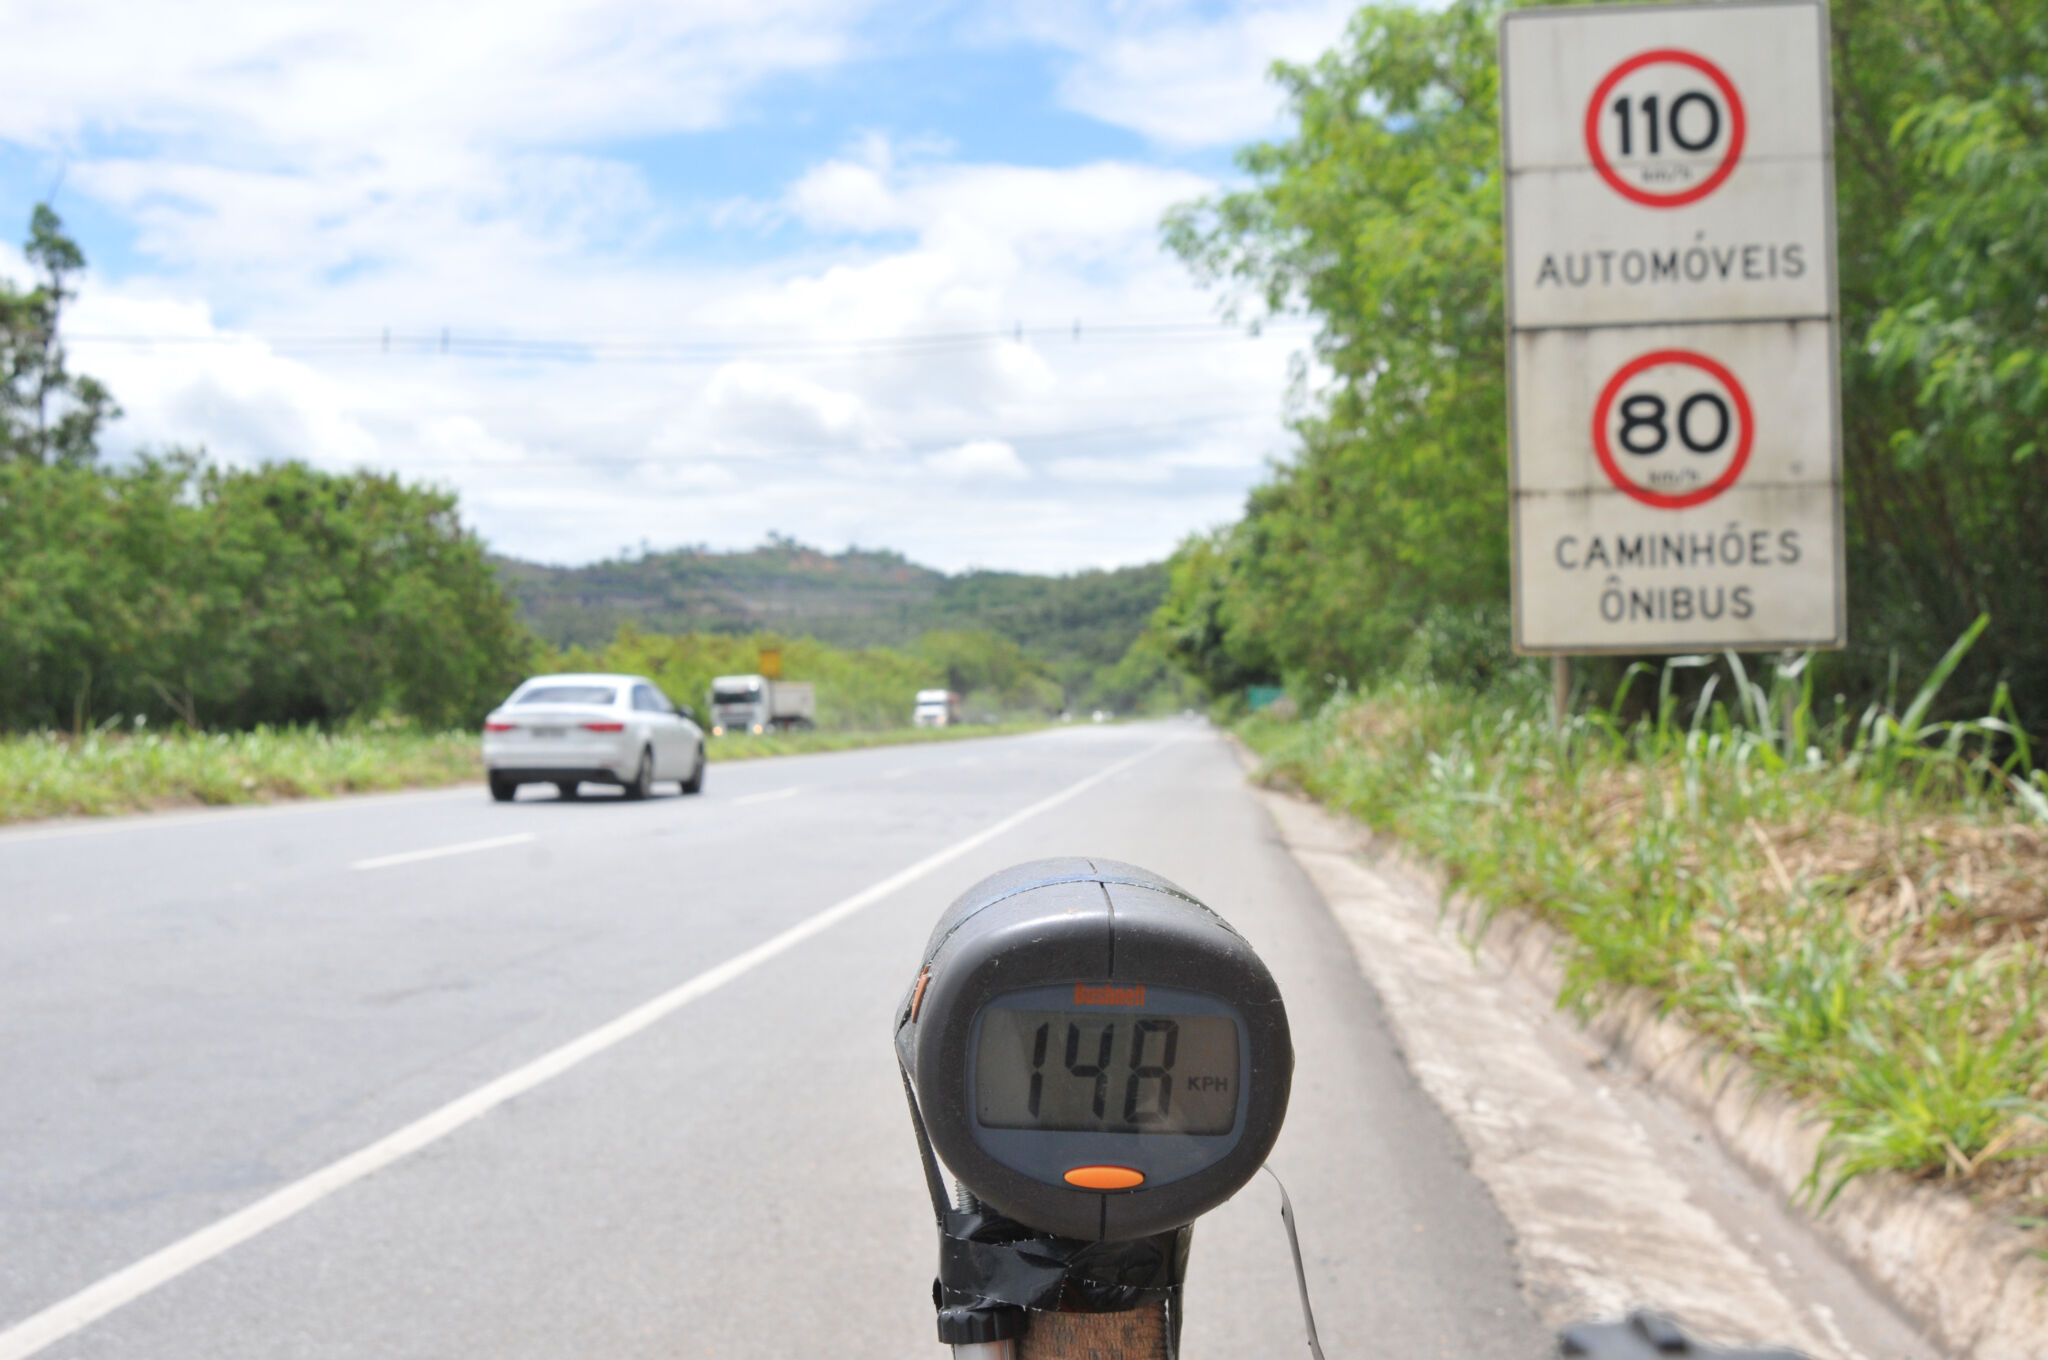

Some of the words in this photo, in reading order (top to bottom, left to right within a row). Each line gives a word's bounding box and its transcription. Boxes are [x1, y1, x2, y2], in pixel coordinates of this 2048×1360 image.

[1613, 91, 1721, 156] 110
[1536, 231, 1806, 288] AUTOMÓVEIS
[1619, 392, 1731, 456] 80
[1600, 574, 1756, 623] ÔNIBUS
[1074, 980, 1146, 1006] Bushnell
[1028, 1019, 1180, 1124] 148
[1188, 1075, 1229, 1092] KPH
